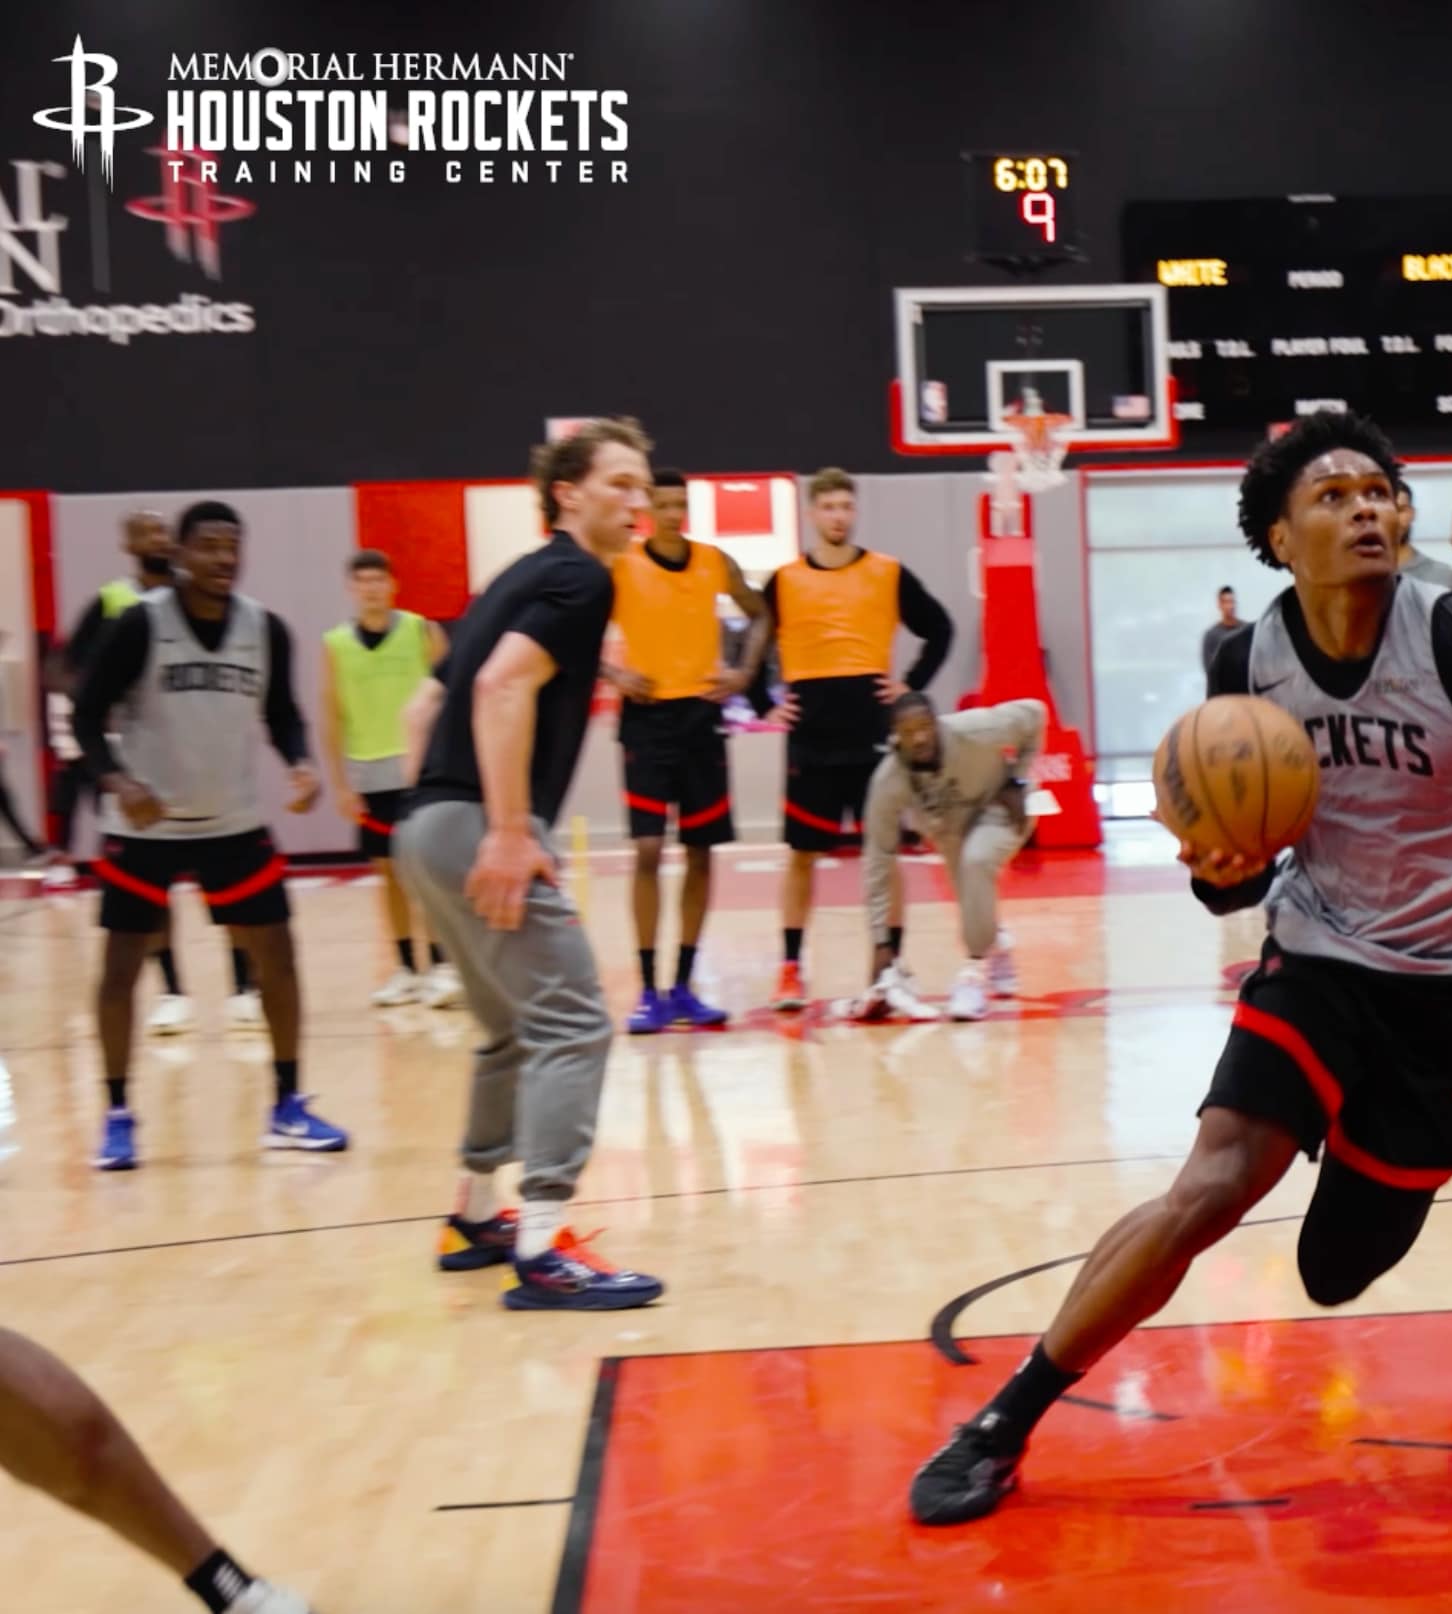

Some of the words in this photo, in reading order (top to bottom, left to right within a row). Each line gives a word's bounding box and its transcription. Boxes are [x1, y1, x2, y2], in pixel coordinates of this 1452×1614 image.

[994, 157, 1068, 192] 6:07
[1022, 191, 1056, 242] 9
[1157, 258, 1228, 286] WHITE
